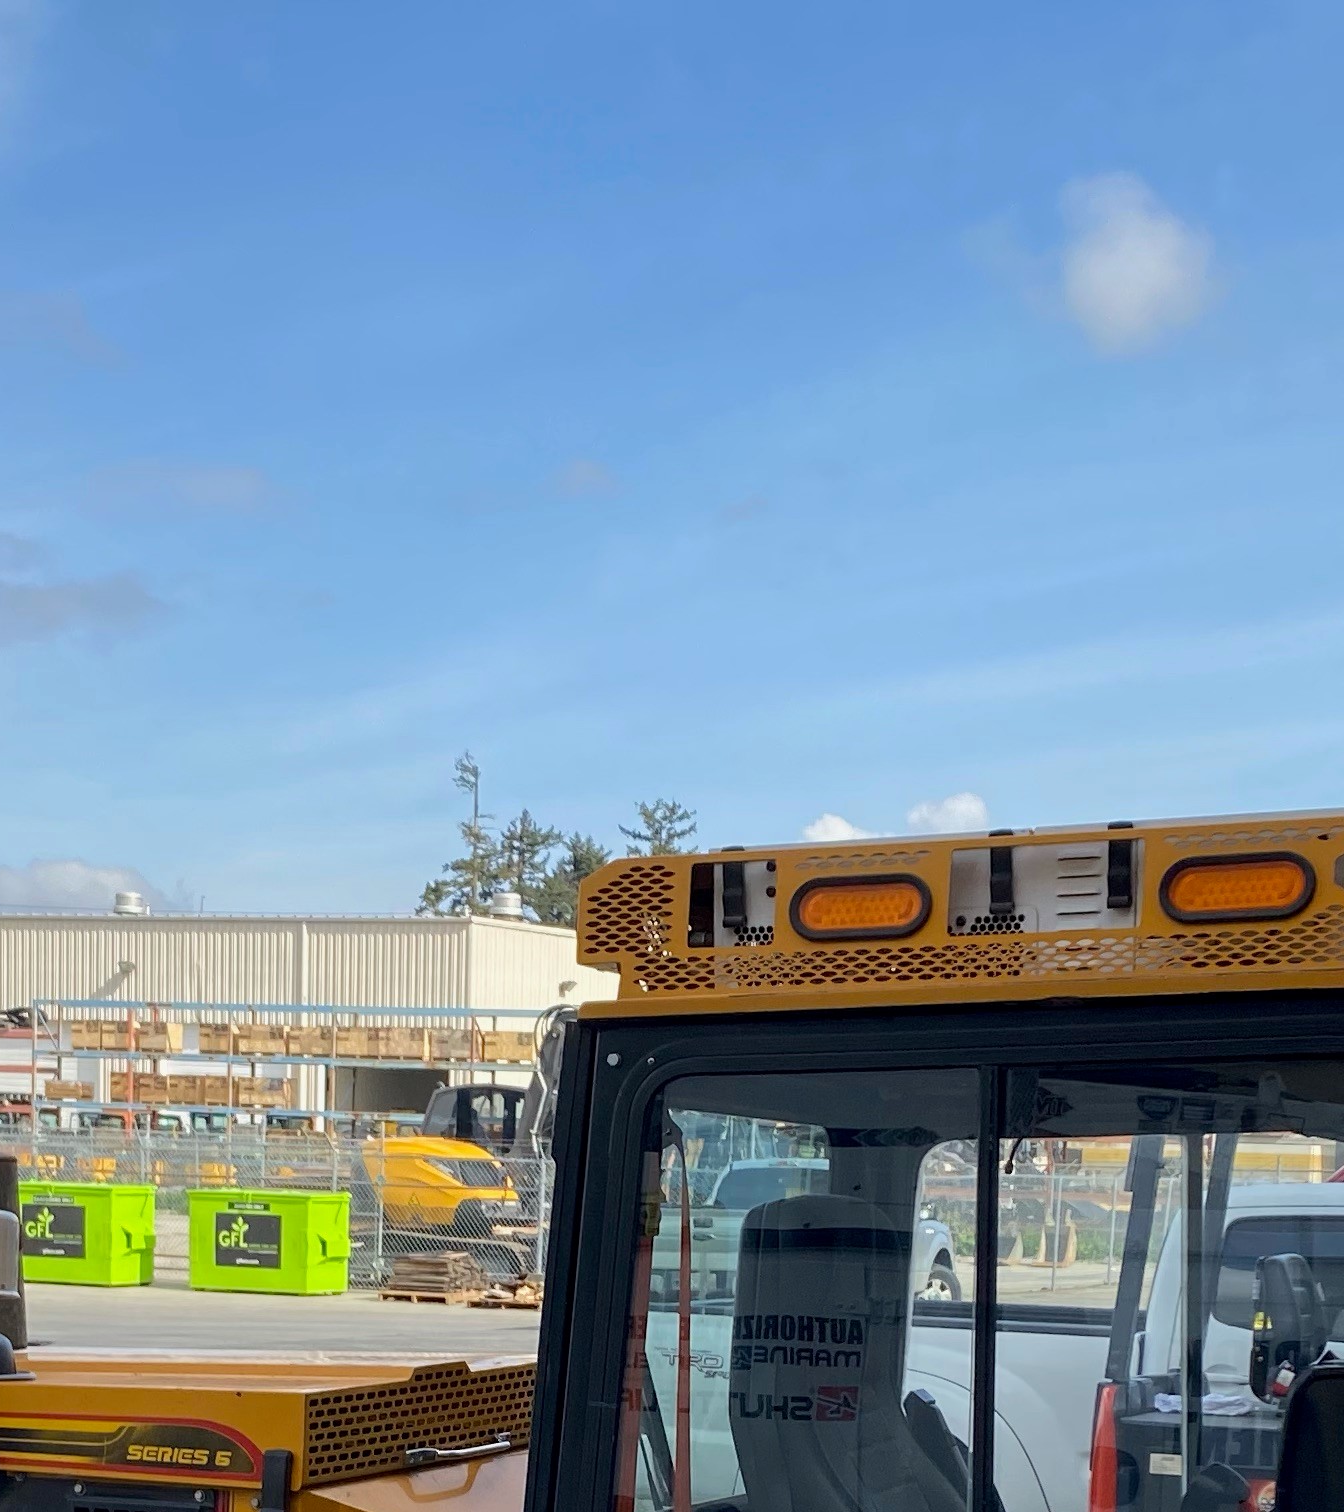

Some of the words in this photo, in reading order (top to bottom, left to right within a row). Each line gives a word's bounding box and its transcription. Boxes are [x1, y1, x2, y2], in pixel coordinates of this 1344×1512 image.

[218, 1223, 248, 1249] GFL
[126, 1444, 210, 1466] SERIES
[214, 1449, 232, 1467] 6
